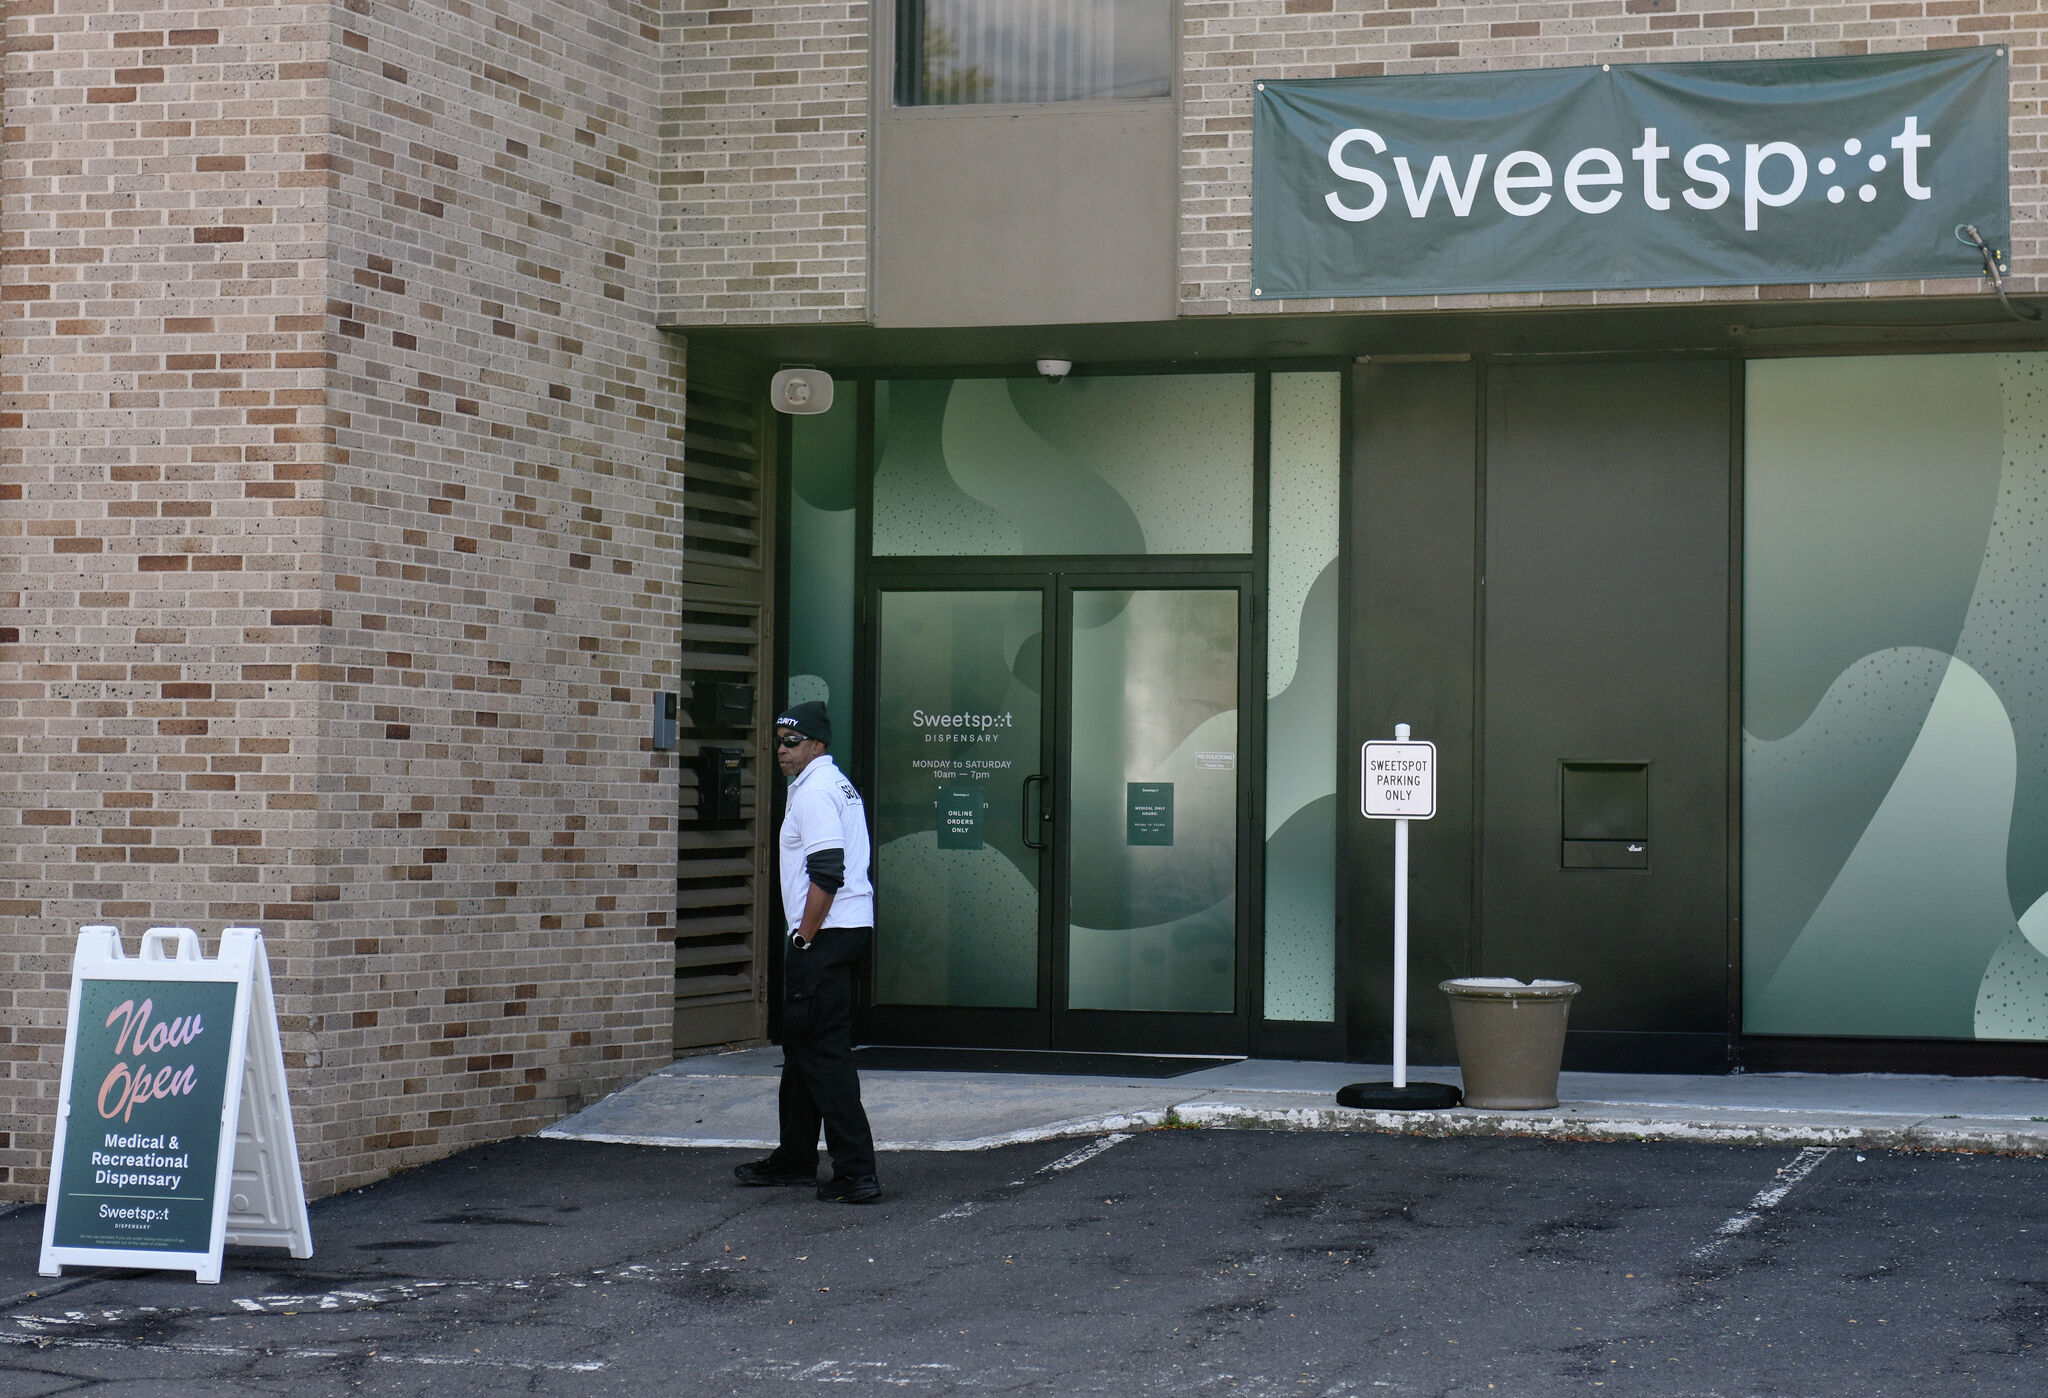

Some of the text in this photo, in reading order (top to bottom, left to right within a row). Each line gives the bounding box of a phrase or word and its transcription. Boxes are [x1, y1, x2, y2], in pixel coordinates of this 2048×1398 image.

[925, 734, 999, 743] DISPENSARY
[912, 760, 951, 769] MONDAY
[965, 760, 1012, 769] SATURDAY
[1371, 760, 1427, 772] SWEETSPOT
[933, 771, 956, 779] 10am
[971, 771, 990, 780] 7pm
[1377, 775, 1421, 786] PARKING
[1385, 789, 1412, 801] ONLY
[106, 998, 203, 1056] Now
[97, 1062, 197, 1123] Open
[104, 1133, 180, 1150] Medical &
[91, 1152, 189, 1169] Recreational
[95, 1170, 181, 1191] Dispensary
